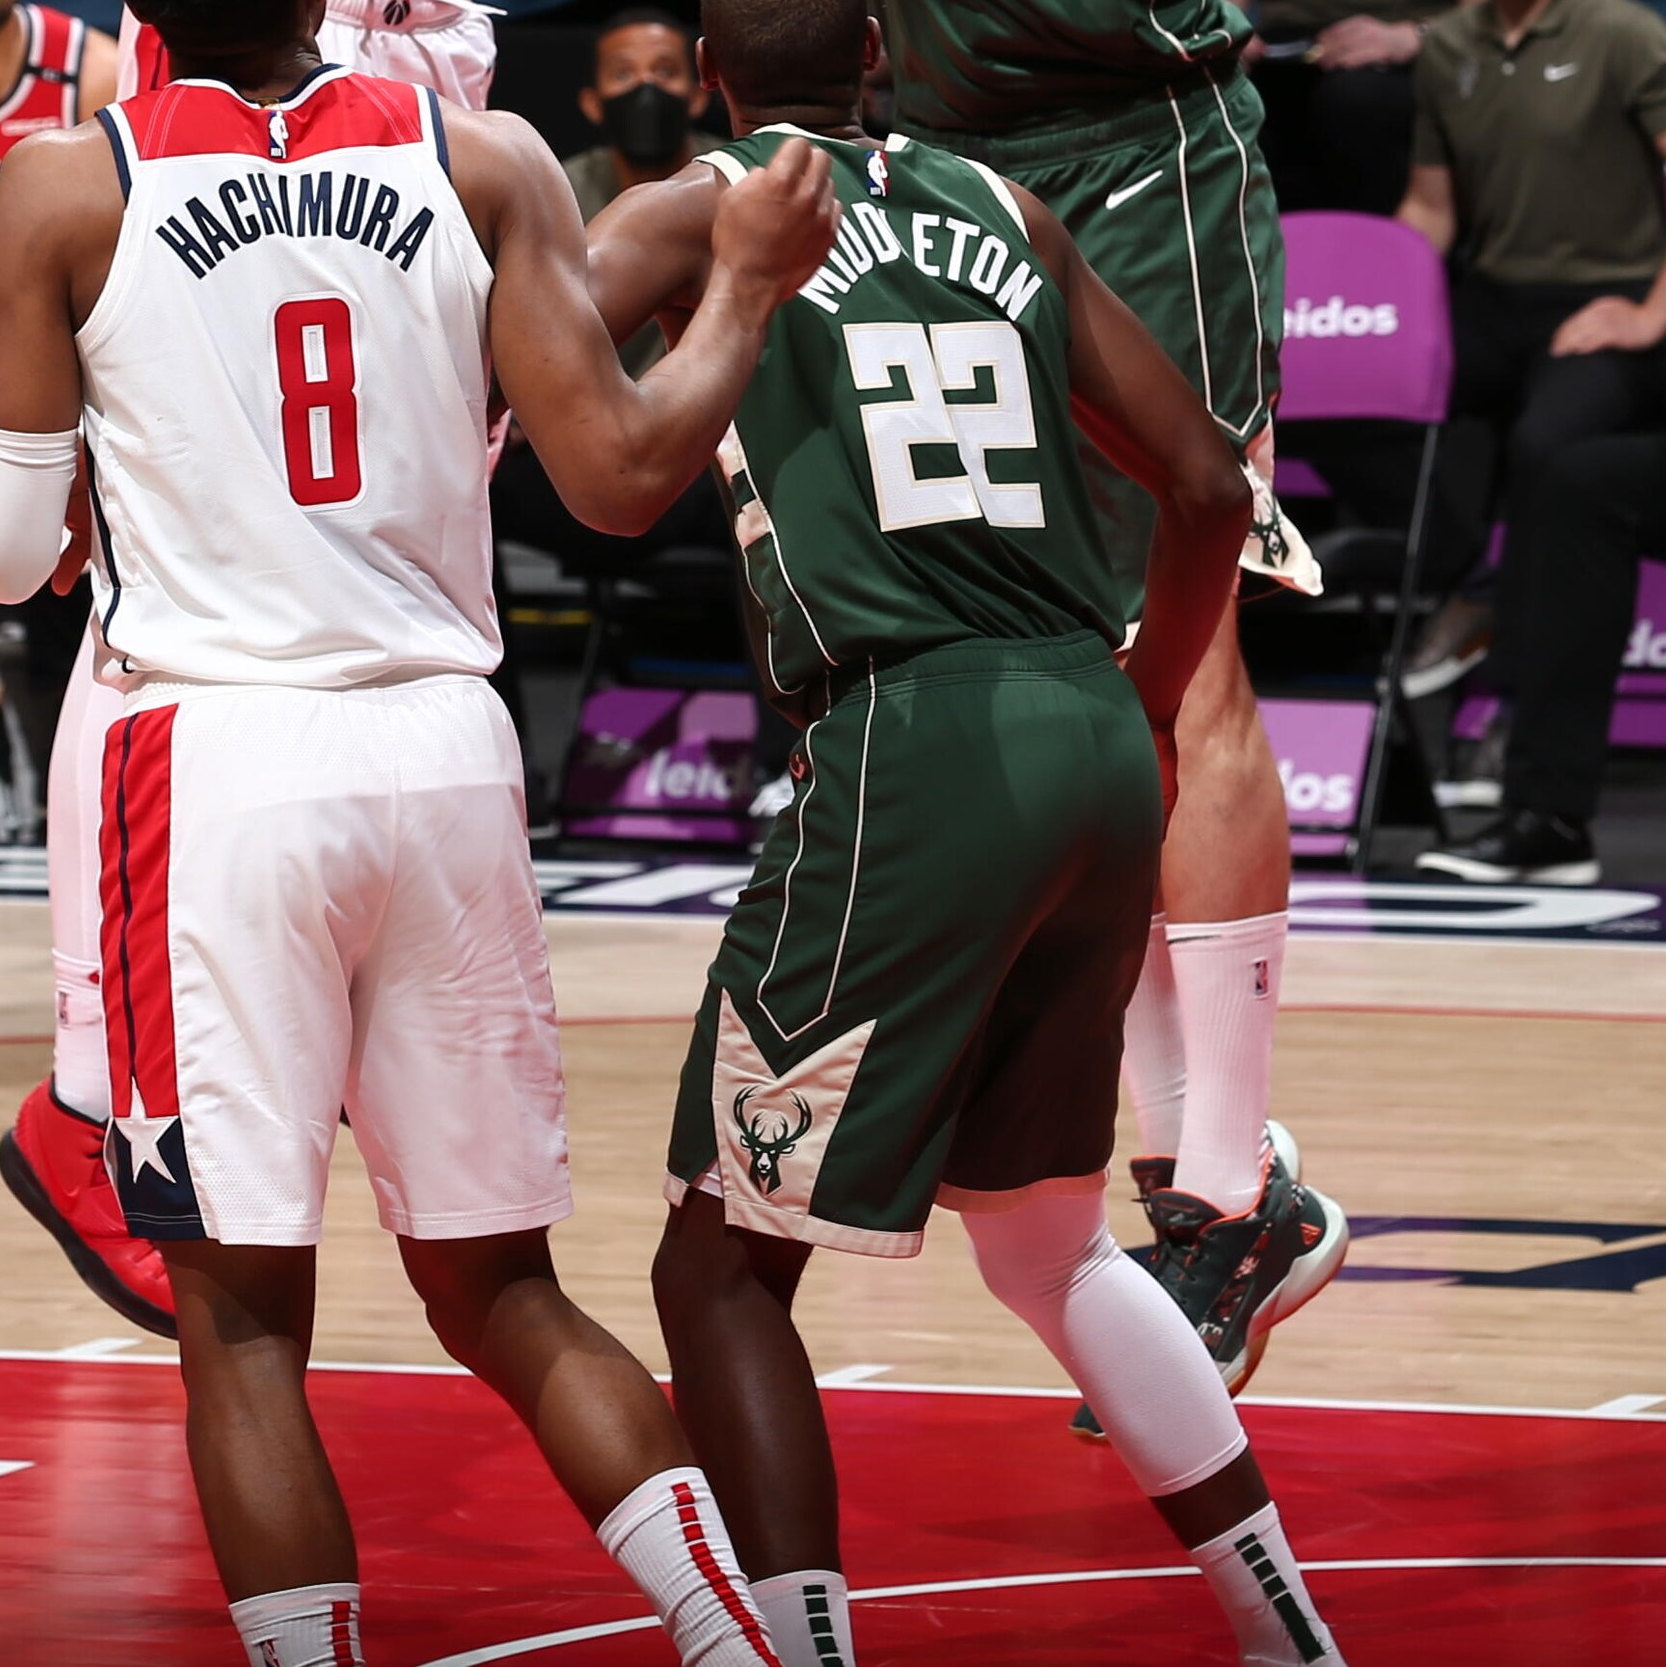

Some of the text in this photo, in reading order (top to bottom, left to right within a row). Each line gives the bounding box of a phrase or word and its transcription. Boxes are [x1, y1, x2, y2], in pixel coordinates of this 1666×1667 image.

[155, 170, 435, 280] HACHIMURA
[796, 201, 1044, 322] MIDDETON
[271, 293, 365, 510] 8
[842, 321, 1047, 532] 22
